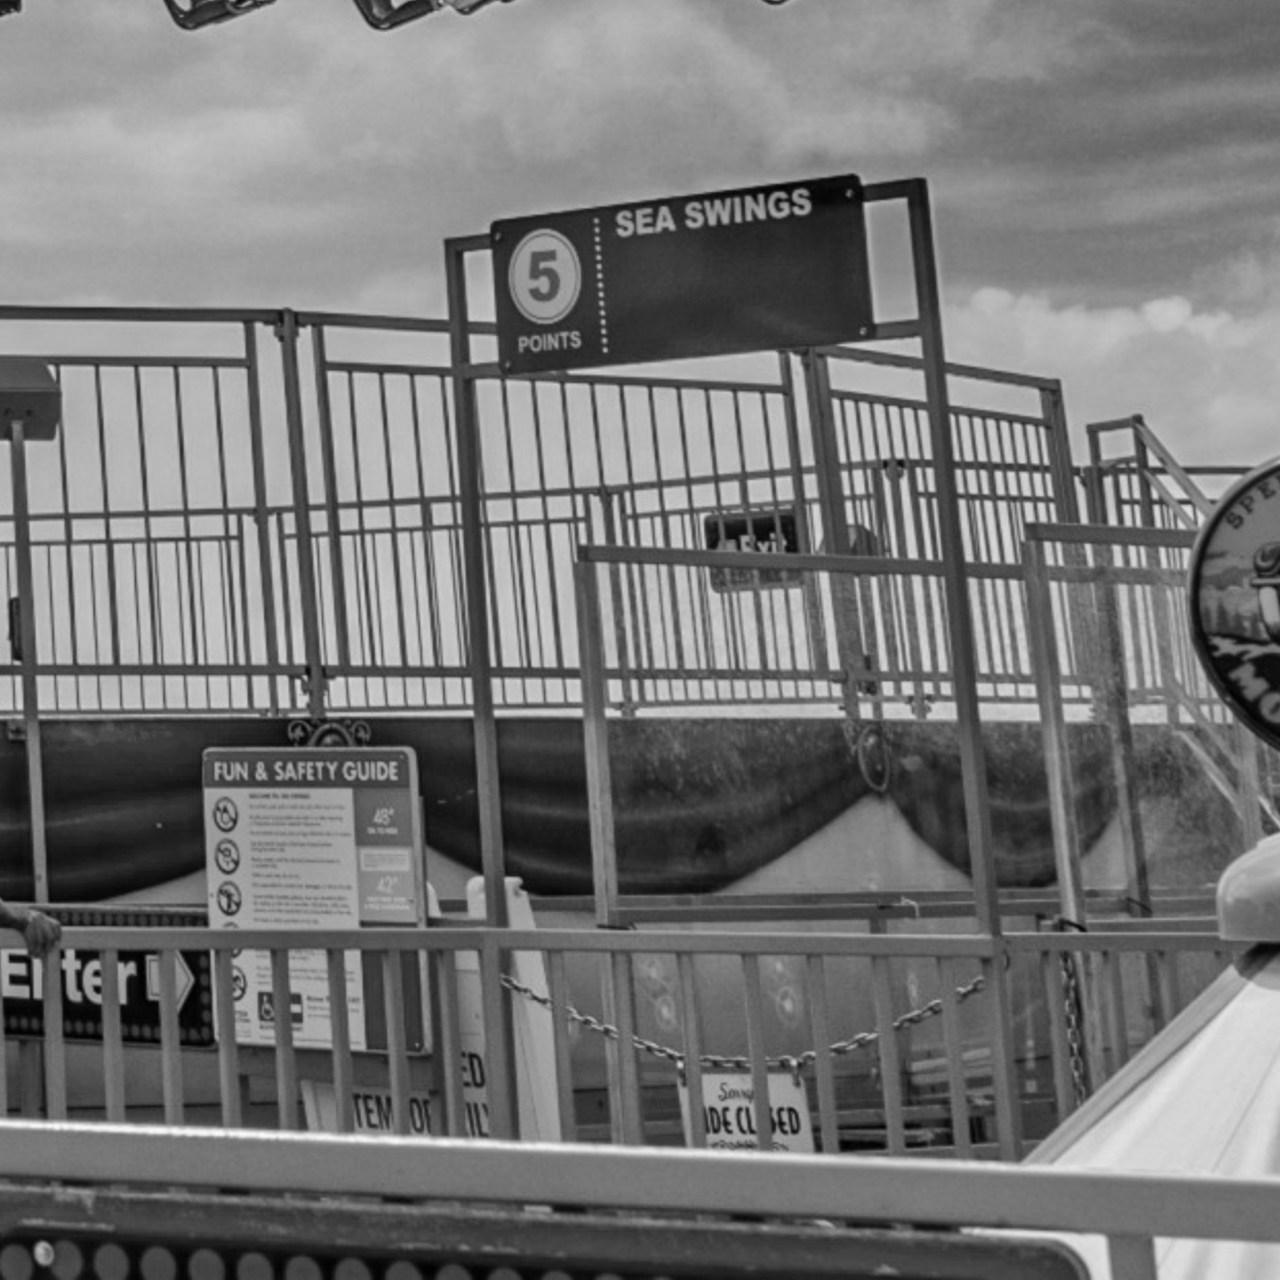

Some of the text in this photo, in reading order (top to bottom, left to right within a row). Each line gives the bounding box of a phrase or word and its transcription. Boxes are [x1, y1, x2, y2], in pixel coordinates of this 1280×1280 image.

[615, 188, 813, 238] SEA SWINGS
[527, 249, 561, 303] 5
[517, 330, 582, 354] POINTS
[213, 760, 399, 781] FUN & SAFETY GUIDE
